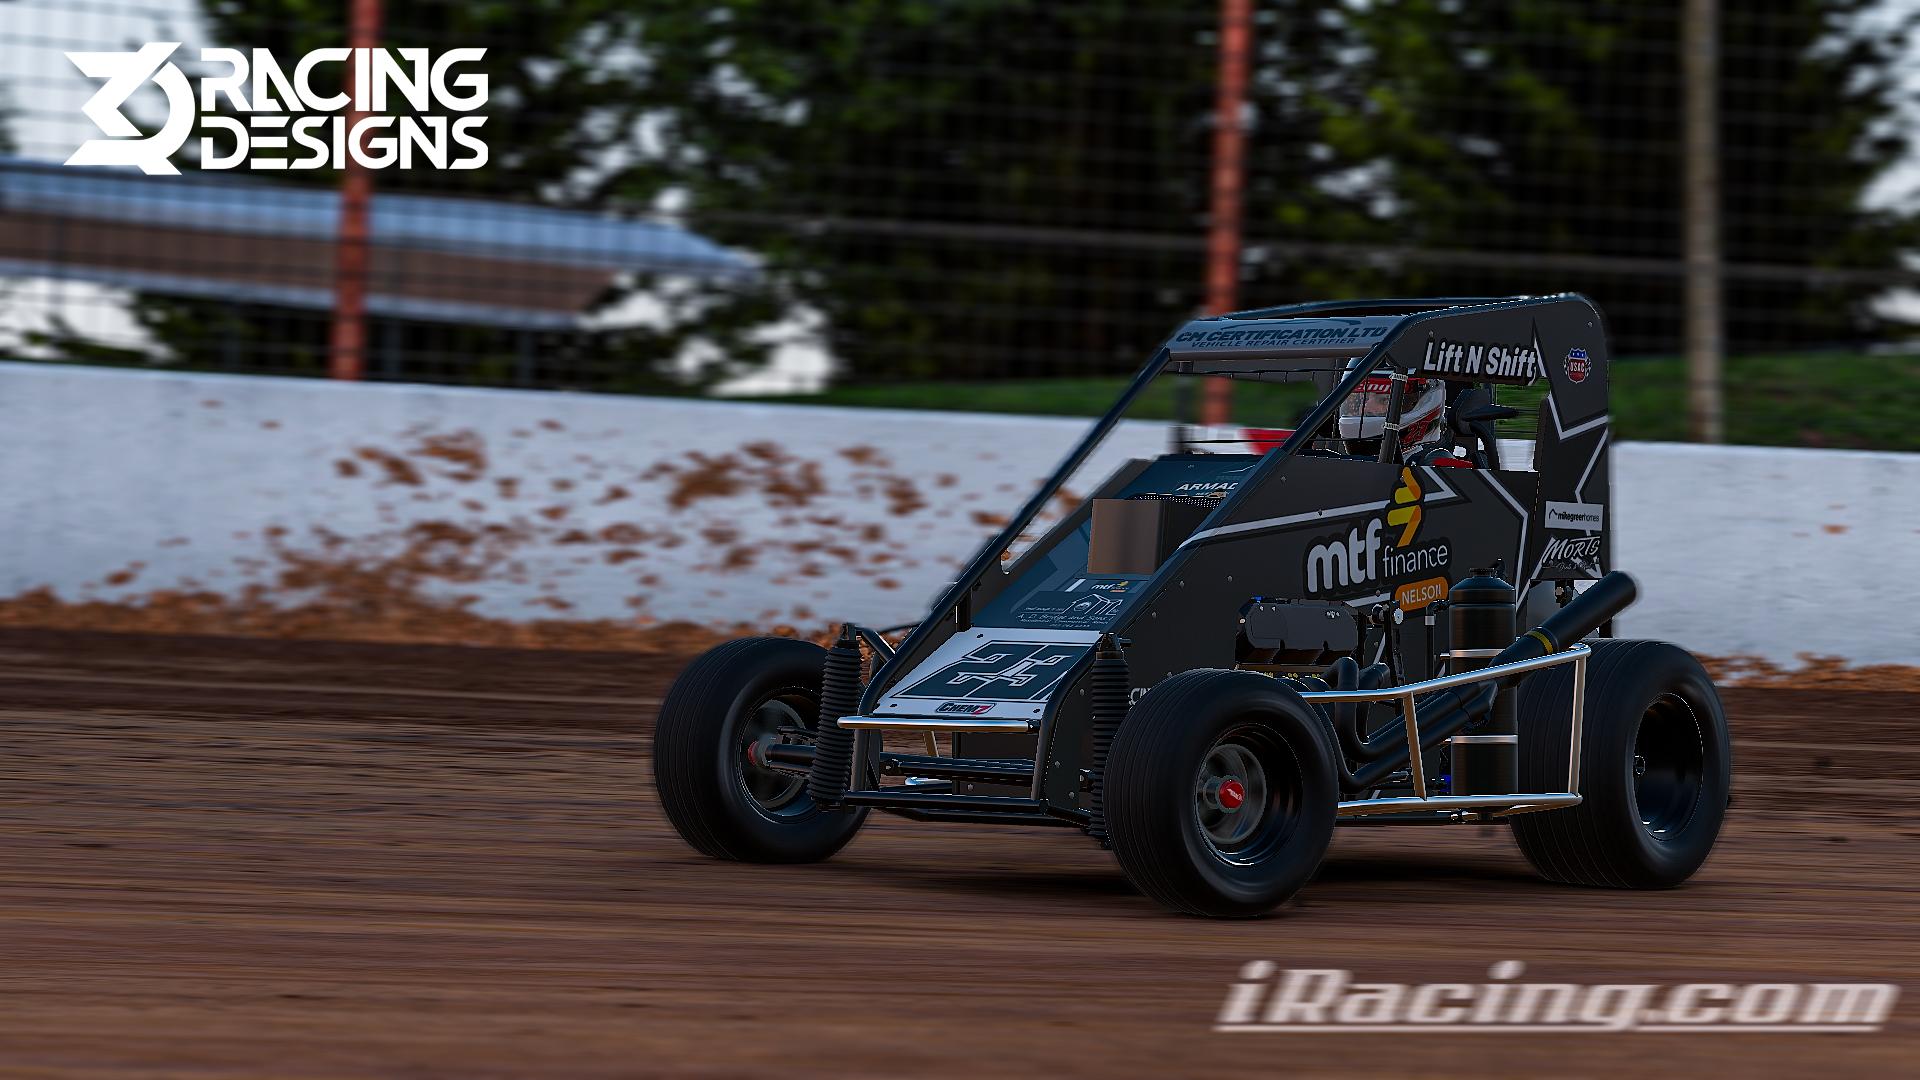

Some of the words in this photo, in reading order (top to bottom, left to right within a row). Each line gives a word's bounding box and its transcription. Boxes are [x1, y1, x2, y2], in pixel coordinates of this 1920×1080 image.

[1191, 340, 1242, 348] VEHICLE
[1246, 339, 1289, 347] REPAIR
[1293, 338, 1356, 346] CERTIFIER
[1207, 328, 1350, 341] CERTIFICATION
[1348, 326, 1389, 338] LTD
[1423, 341, 1464, 373] Lift
[1465, 345, 1484, 374] N
[1485, 346, 1537, 378] Shift
[1569, 361, 1586, 373] USAC
[1307, 517, 1383, 593] mtf
[1382, 544, 1449, 577] finance
[1542, 536, 1601, 564] MORTS
[1401, 583, 1442, 606] NELSON
[889, 639, 1095, 702] 23
